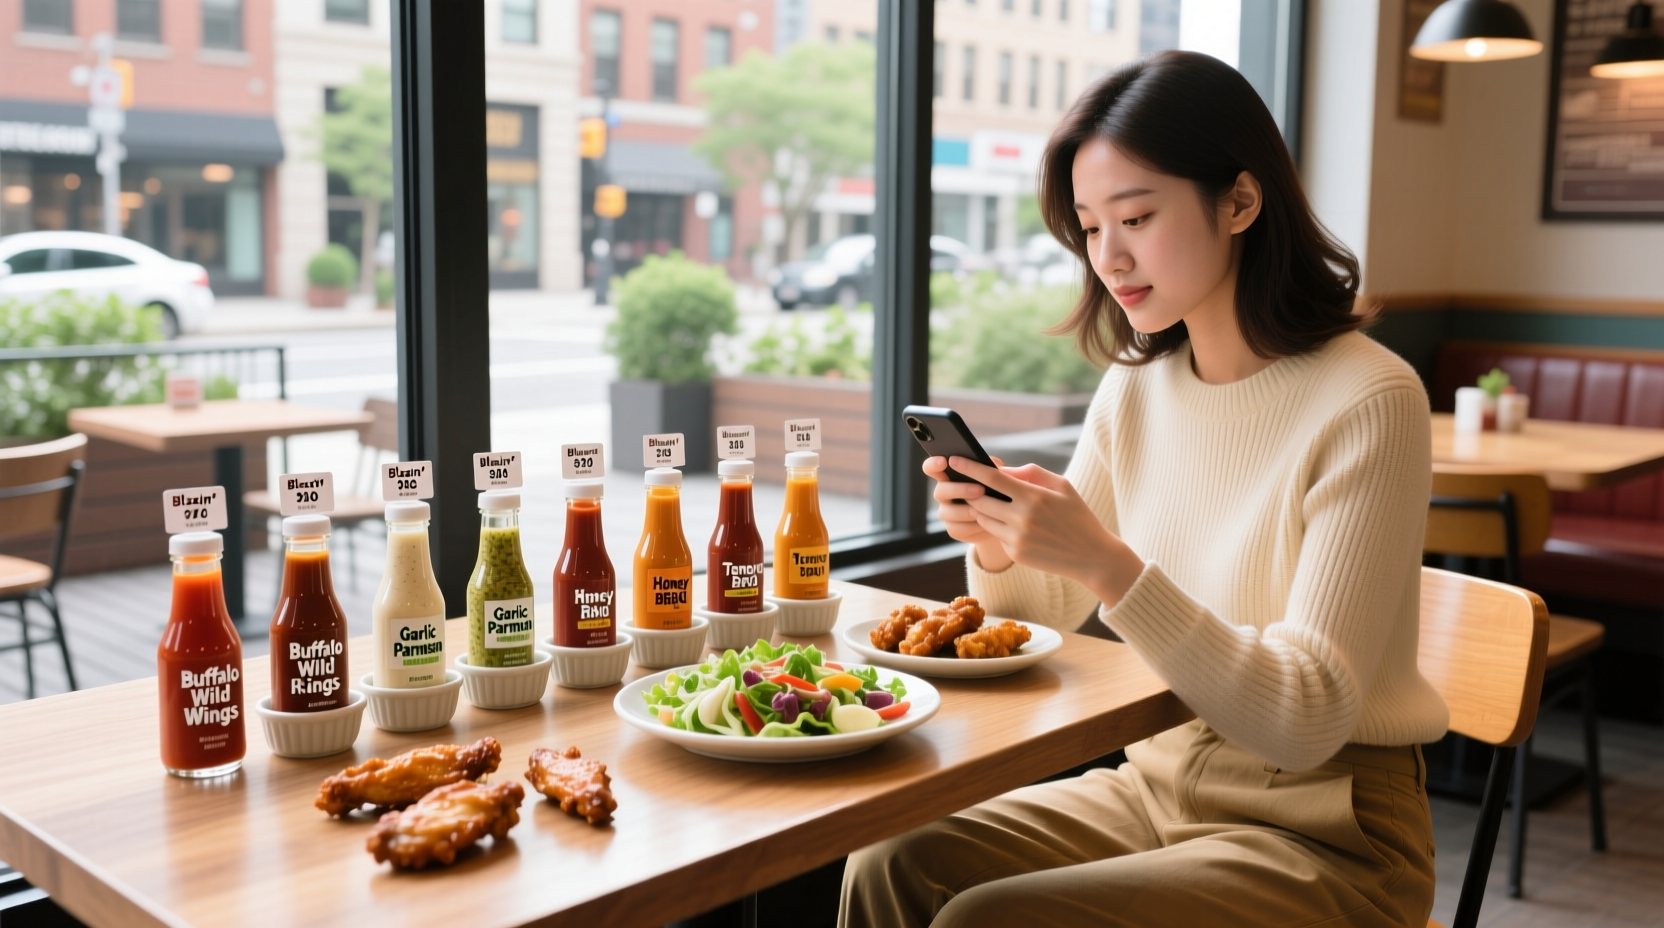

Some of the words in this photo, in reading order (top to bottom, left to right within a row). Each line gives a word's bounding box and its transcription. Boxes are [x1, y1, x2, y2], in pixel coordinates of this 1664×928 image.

[653, 576, 690, 590] Honey
[493, 605, 528, 621] Garlic
[399, 623, 436, 641] Garlic
[289, 639, 343, 660] Buffalo
[181, 664, 240, 689] Buffalo
[297, 657, 335, 678] Wild
[190, 684, 231, 707] Wild
[183, 704, 240, 726] Wings
